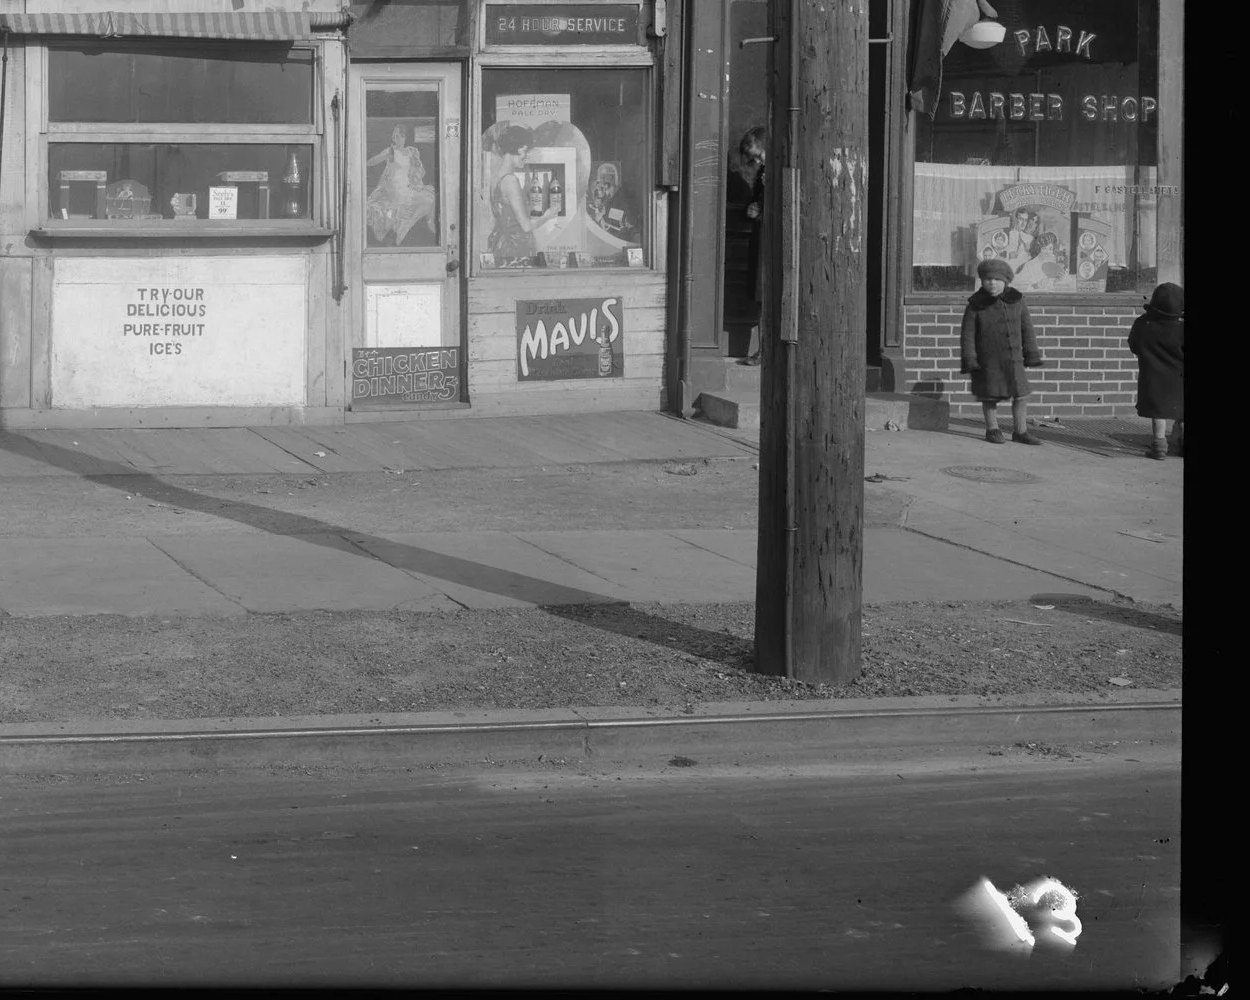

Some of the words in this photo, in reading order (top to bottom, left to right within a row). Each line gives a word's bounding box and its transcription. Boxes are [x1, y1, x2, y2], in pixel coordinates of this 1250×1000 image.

[498, 17, 516, 31] 24
[567, 18, 626, 32] SERVICE
[1014, 25, 1097, 60] PARK
[508, 100, 559, 109] HOFFMAN
[950, 91, 1064, 121] BARBER
[1082, 94, 1157, 122] SHOP
[127, 304, 206, 317] DELICIOUS
[525, 301, 568, 315] Drink
[123, 324, 206, 336] PURE-FRUIT
[520, 298, 619, 377] MAVIS
[353, 349, 457, 378] CHICKEN
[353, 370, 444, 398] DINNER
